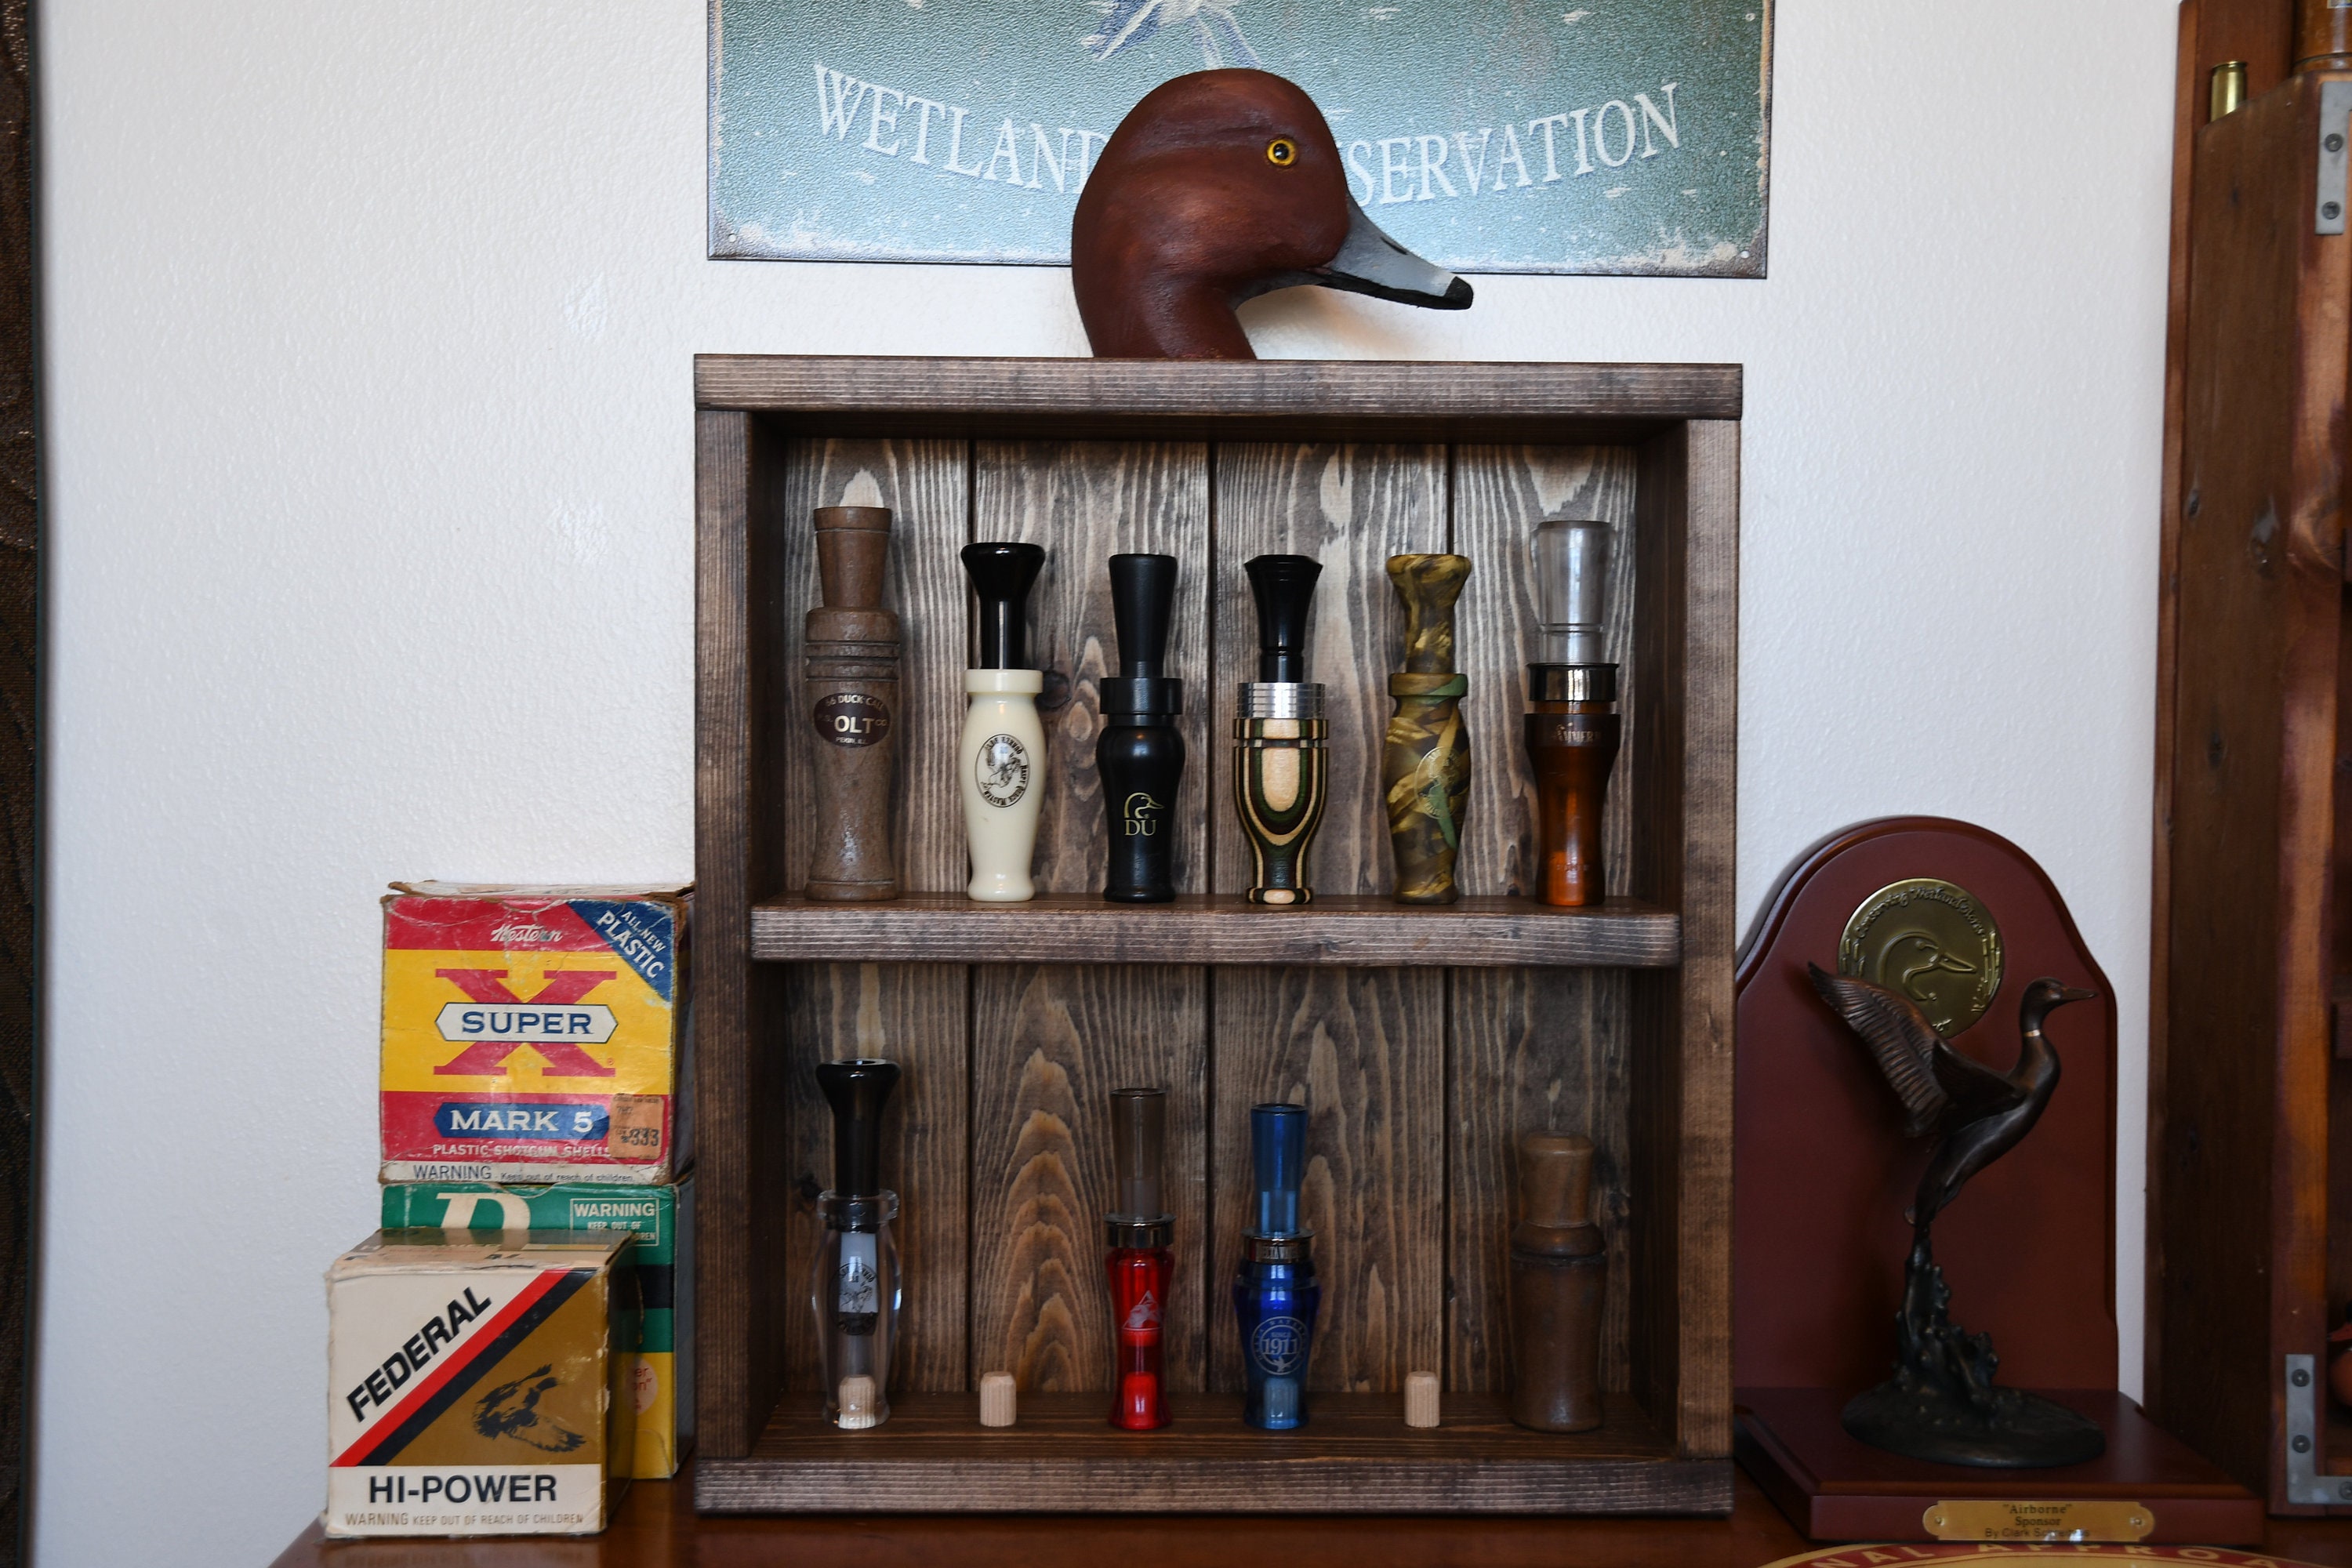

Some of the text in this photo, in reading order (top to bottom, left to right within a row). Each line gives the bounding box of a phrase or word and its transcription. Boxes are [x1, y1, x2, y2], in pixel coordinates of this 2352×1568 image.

[814, 64, 1679, 208] WETLAND SERVATION
[837, 694, 864, 704] DUCK
[834, 715, 874, 734] OLT
[1123, 819, 1157, 837] DU
[489, 923, 564, 942] Western
[596, 909, 666, 979] PLASTIC
[433, 968, 617, 1078] X
[461, 1011, 593, 1035] SUPER
[450, 1109, 559, 1133] MARK
[574, 1109, 593, 1133] 5
[412, 1163, 492, 1180] WARNING
[500, 1172, 523, 1182] Keep
[525, 1173, 543, 1181] out
[544, 1172, 554, 1181] of
[556, 1171, 583, 1181] reach
[585, 1171, 594, 1181] of
[574, 1202, 655, 1217] WARNING
[587, 1221, 608, 1230] KEEP
[611, 1221, 628, 1229] OUT
[346, 1286, 492, 1423] FEDERAL
[1261, 1338, 1298, 1355] 1911
[368, 1474, 557, 1504] HI-POWER
[2002, 1503, 2072, 1515] "Airborne"
[345, 1512, 584, 1526] WARNING KEEP OUT OF REACH OF CHILDREN
[2015, 1515, 2063, 1527] Sponsor
[1984, 1527, 1999, 1539] By
[2002, 1527, 2031, 1537] Clark
